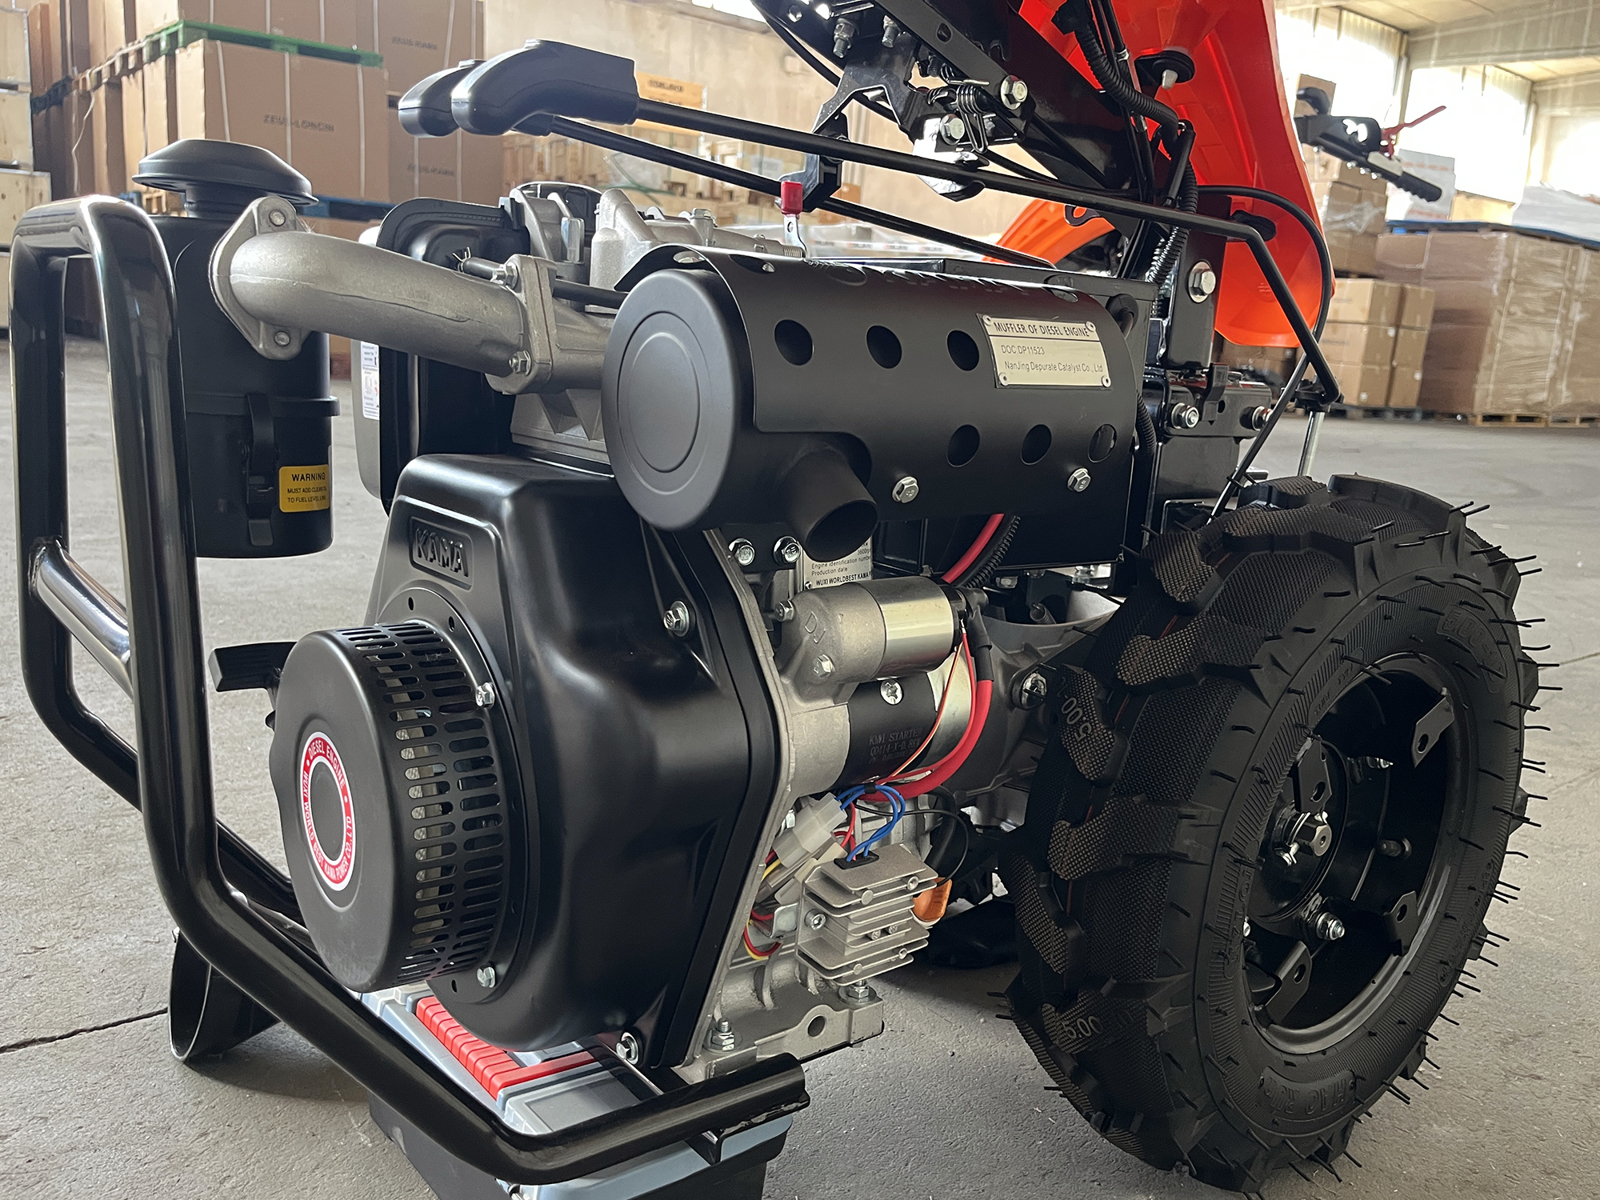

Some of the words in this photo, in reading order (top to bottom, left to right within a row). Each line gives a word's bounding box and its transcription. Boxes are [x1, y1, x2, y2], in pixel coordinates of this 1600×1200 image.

[993, 322, 1027, 334] MUFFLER
[1028, 324, 1038, 334] OF
[1041, 325, 1062, 336] DIESEL
[1064, 326, 1090, 338] ENGINE
[1004, 360, 1030, 373] NanJing
[1030, 361, 1057, 373] Depurate
[1057, 362, 1081, 374] Catalyst
[291, 472, 326, 482] WARNING
[415, 528, 469, 578] KAMA
[811, 562, 828, 570] Engine
[811, 568, 837, 576] Production
[828, 573, 857, 584] WORLDBEST
[888, 728, 923, 742] STARTER
[308, 740, 325, 760] DIESEL
[326, 745, 345, 789] ENGINE
[304, 802, 315, 841] WORLD
